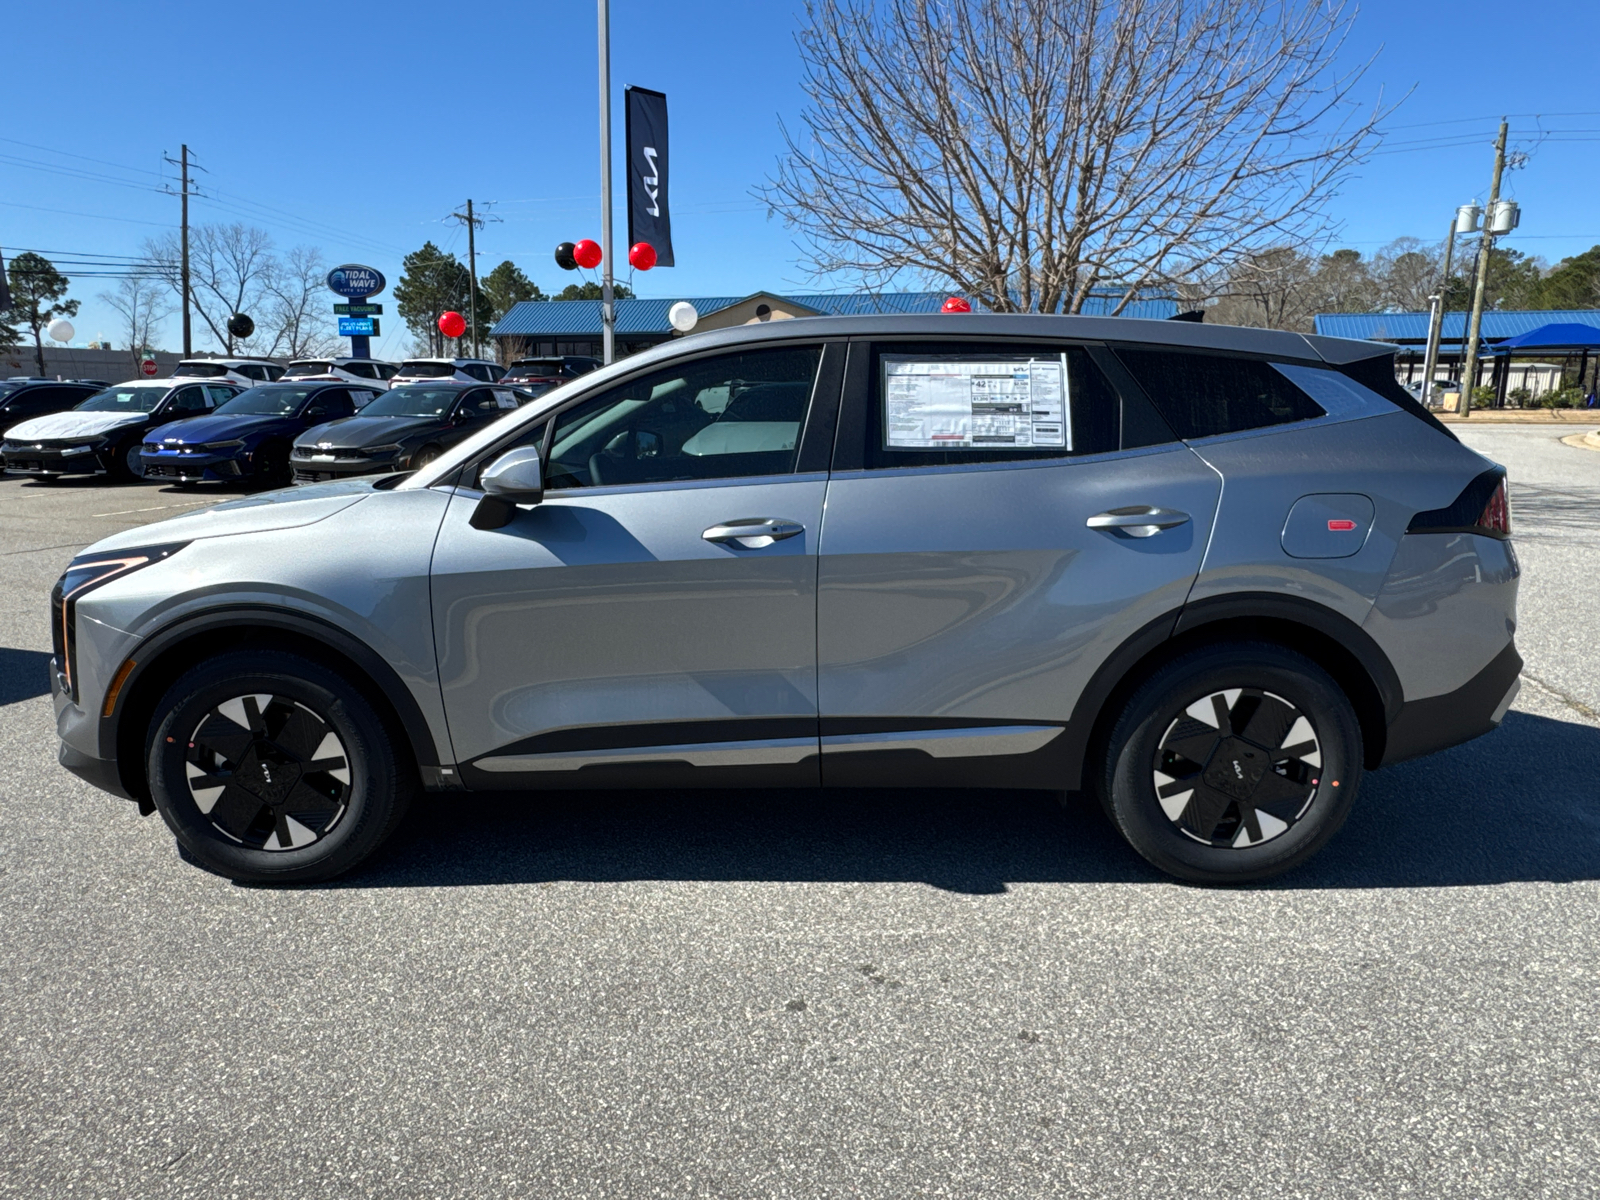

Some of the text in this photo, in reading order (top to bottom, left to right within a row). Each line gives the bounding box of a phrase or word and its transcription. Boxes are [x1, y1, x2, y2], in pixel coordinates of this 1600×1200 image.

[643, 146, 660, 218] KIA
[345, 270, 370, 279] TIDAL
[350, 279, 375, 287] WAVE
